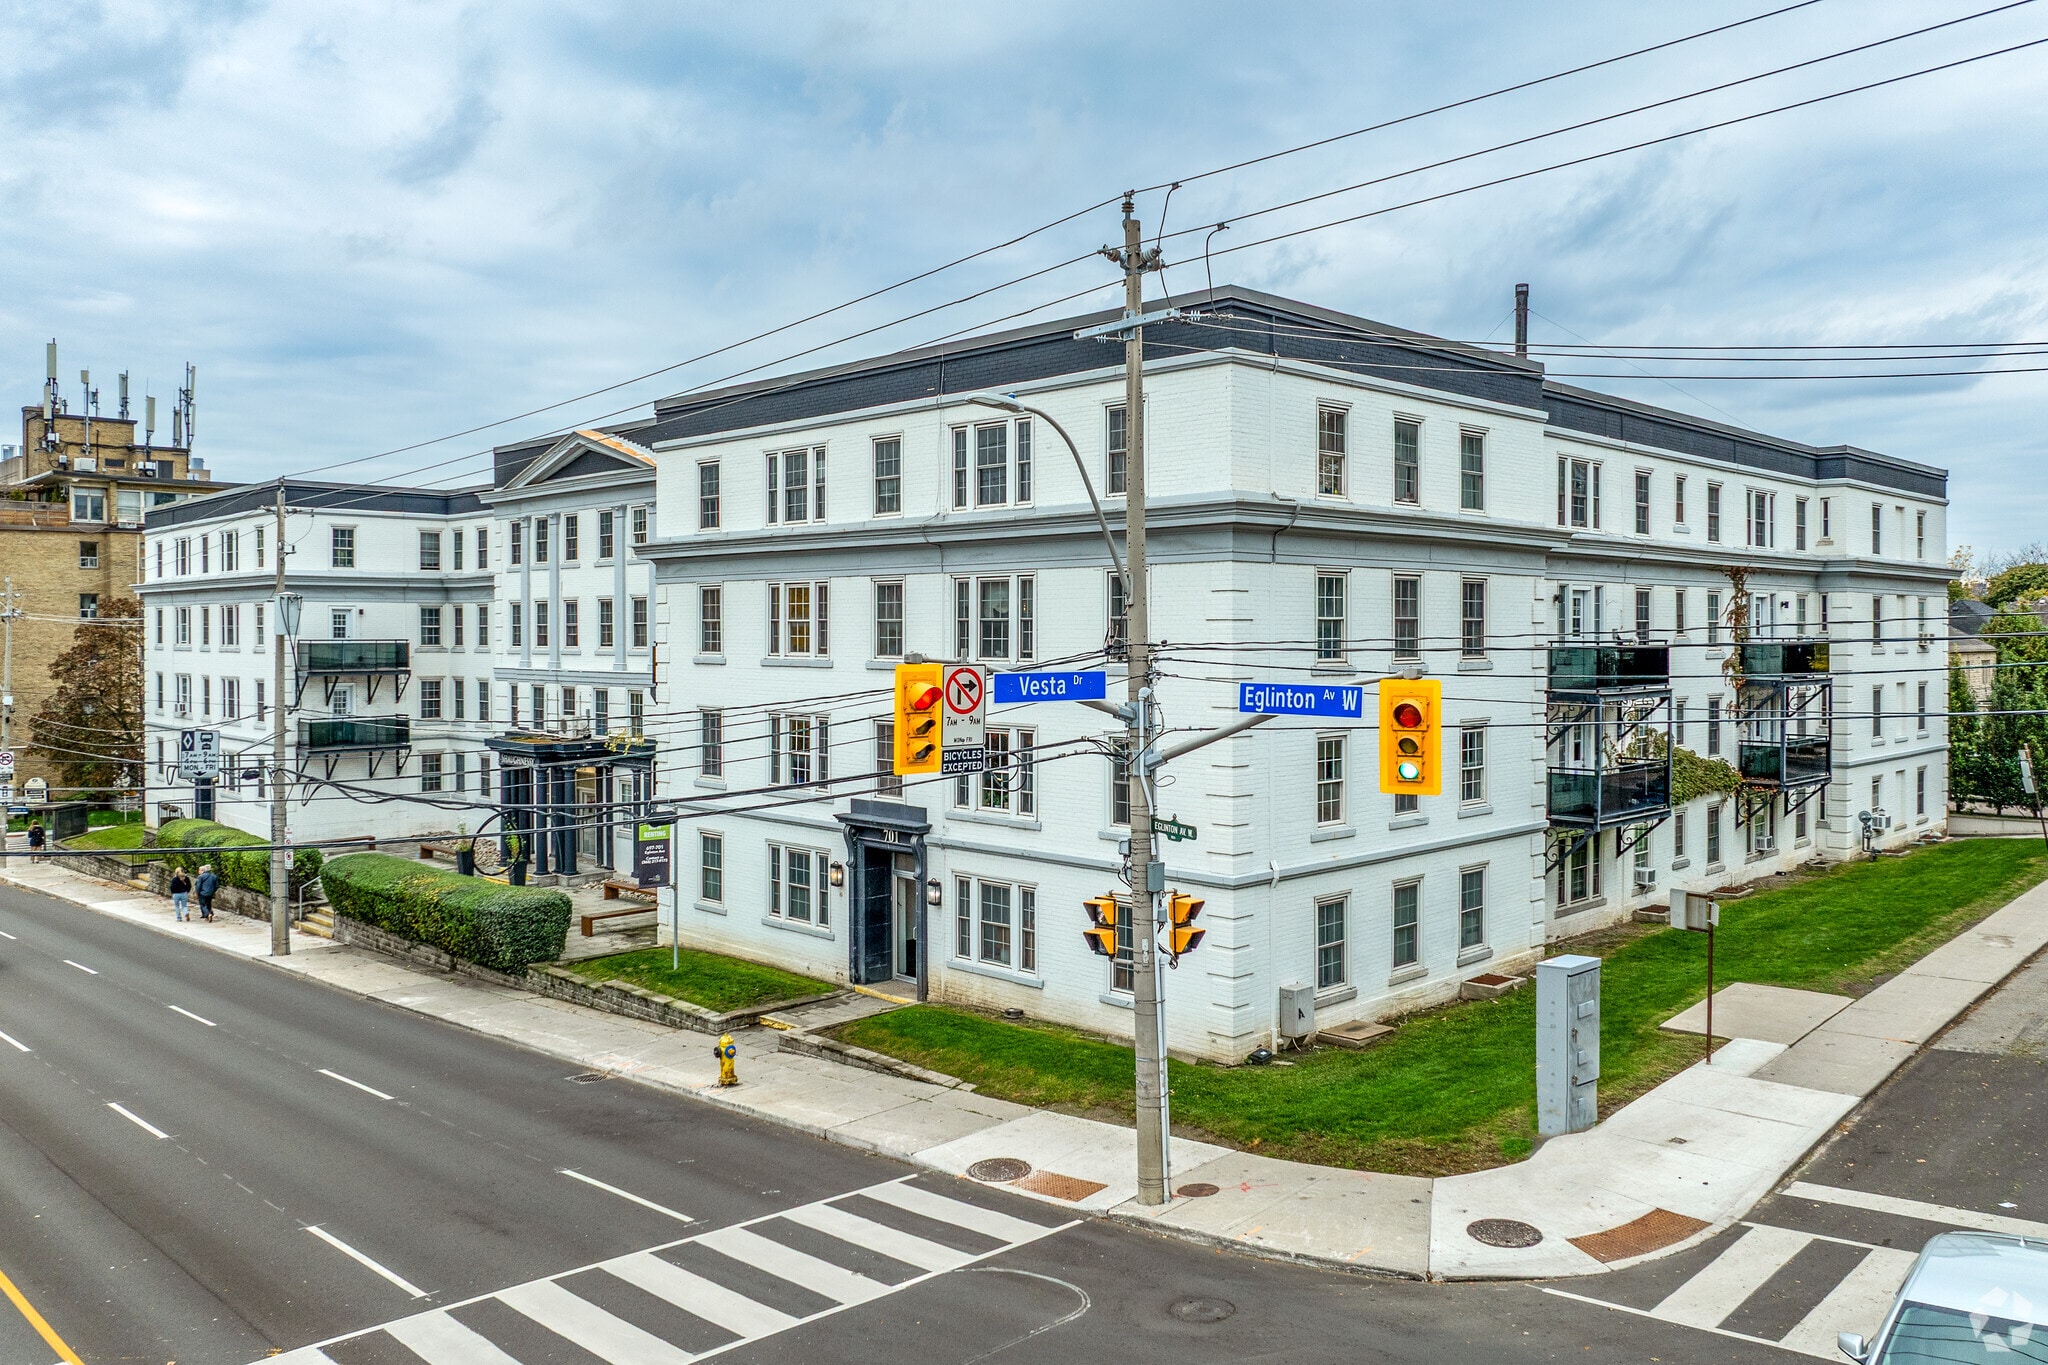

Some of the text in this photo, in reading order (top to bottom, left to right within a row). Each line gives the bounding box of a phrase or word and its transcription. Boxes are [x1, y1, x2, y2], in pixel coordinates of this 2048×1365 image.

[1019, 675, 1083, 696] Vesta Dr
[1244, 686, 1358, 712] Eglinton Av W
[946, 716, 957, 726] 7AM
[969, 715, 980, 725] 9AM
[943, 750, 982, 761] BICYCLES
[943, 761, 982, 772] EXCEPTED
[1154, 821, 1178, 834] EGLINTON
[883, 829, 899, 843] 701
